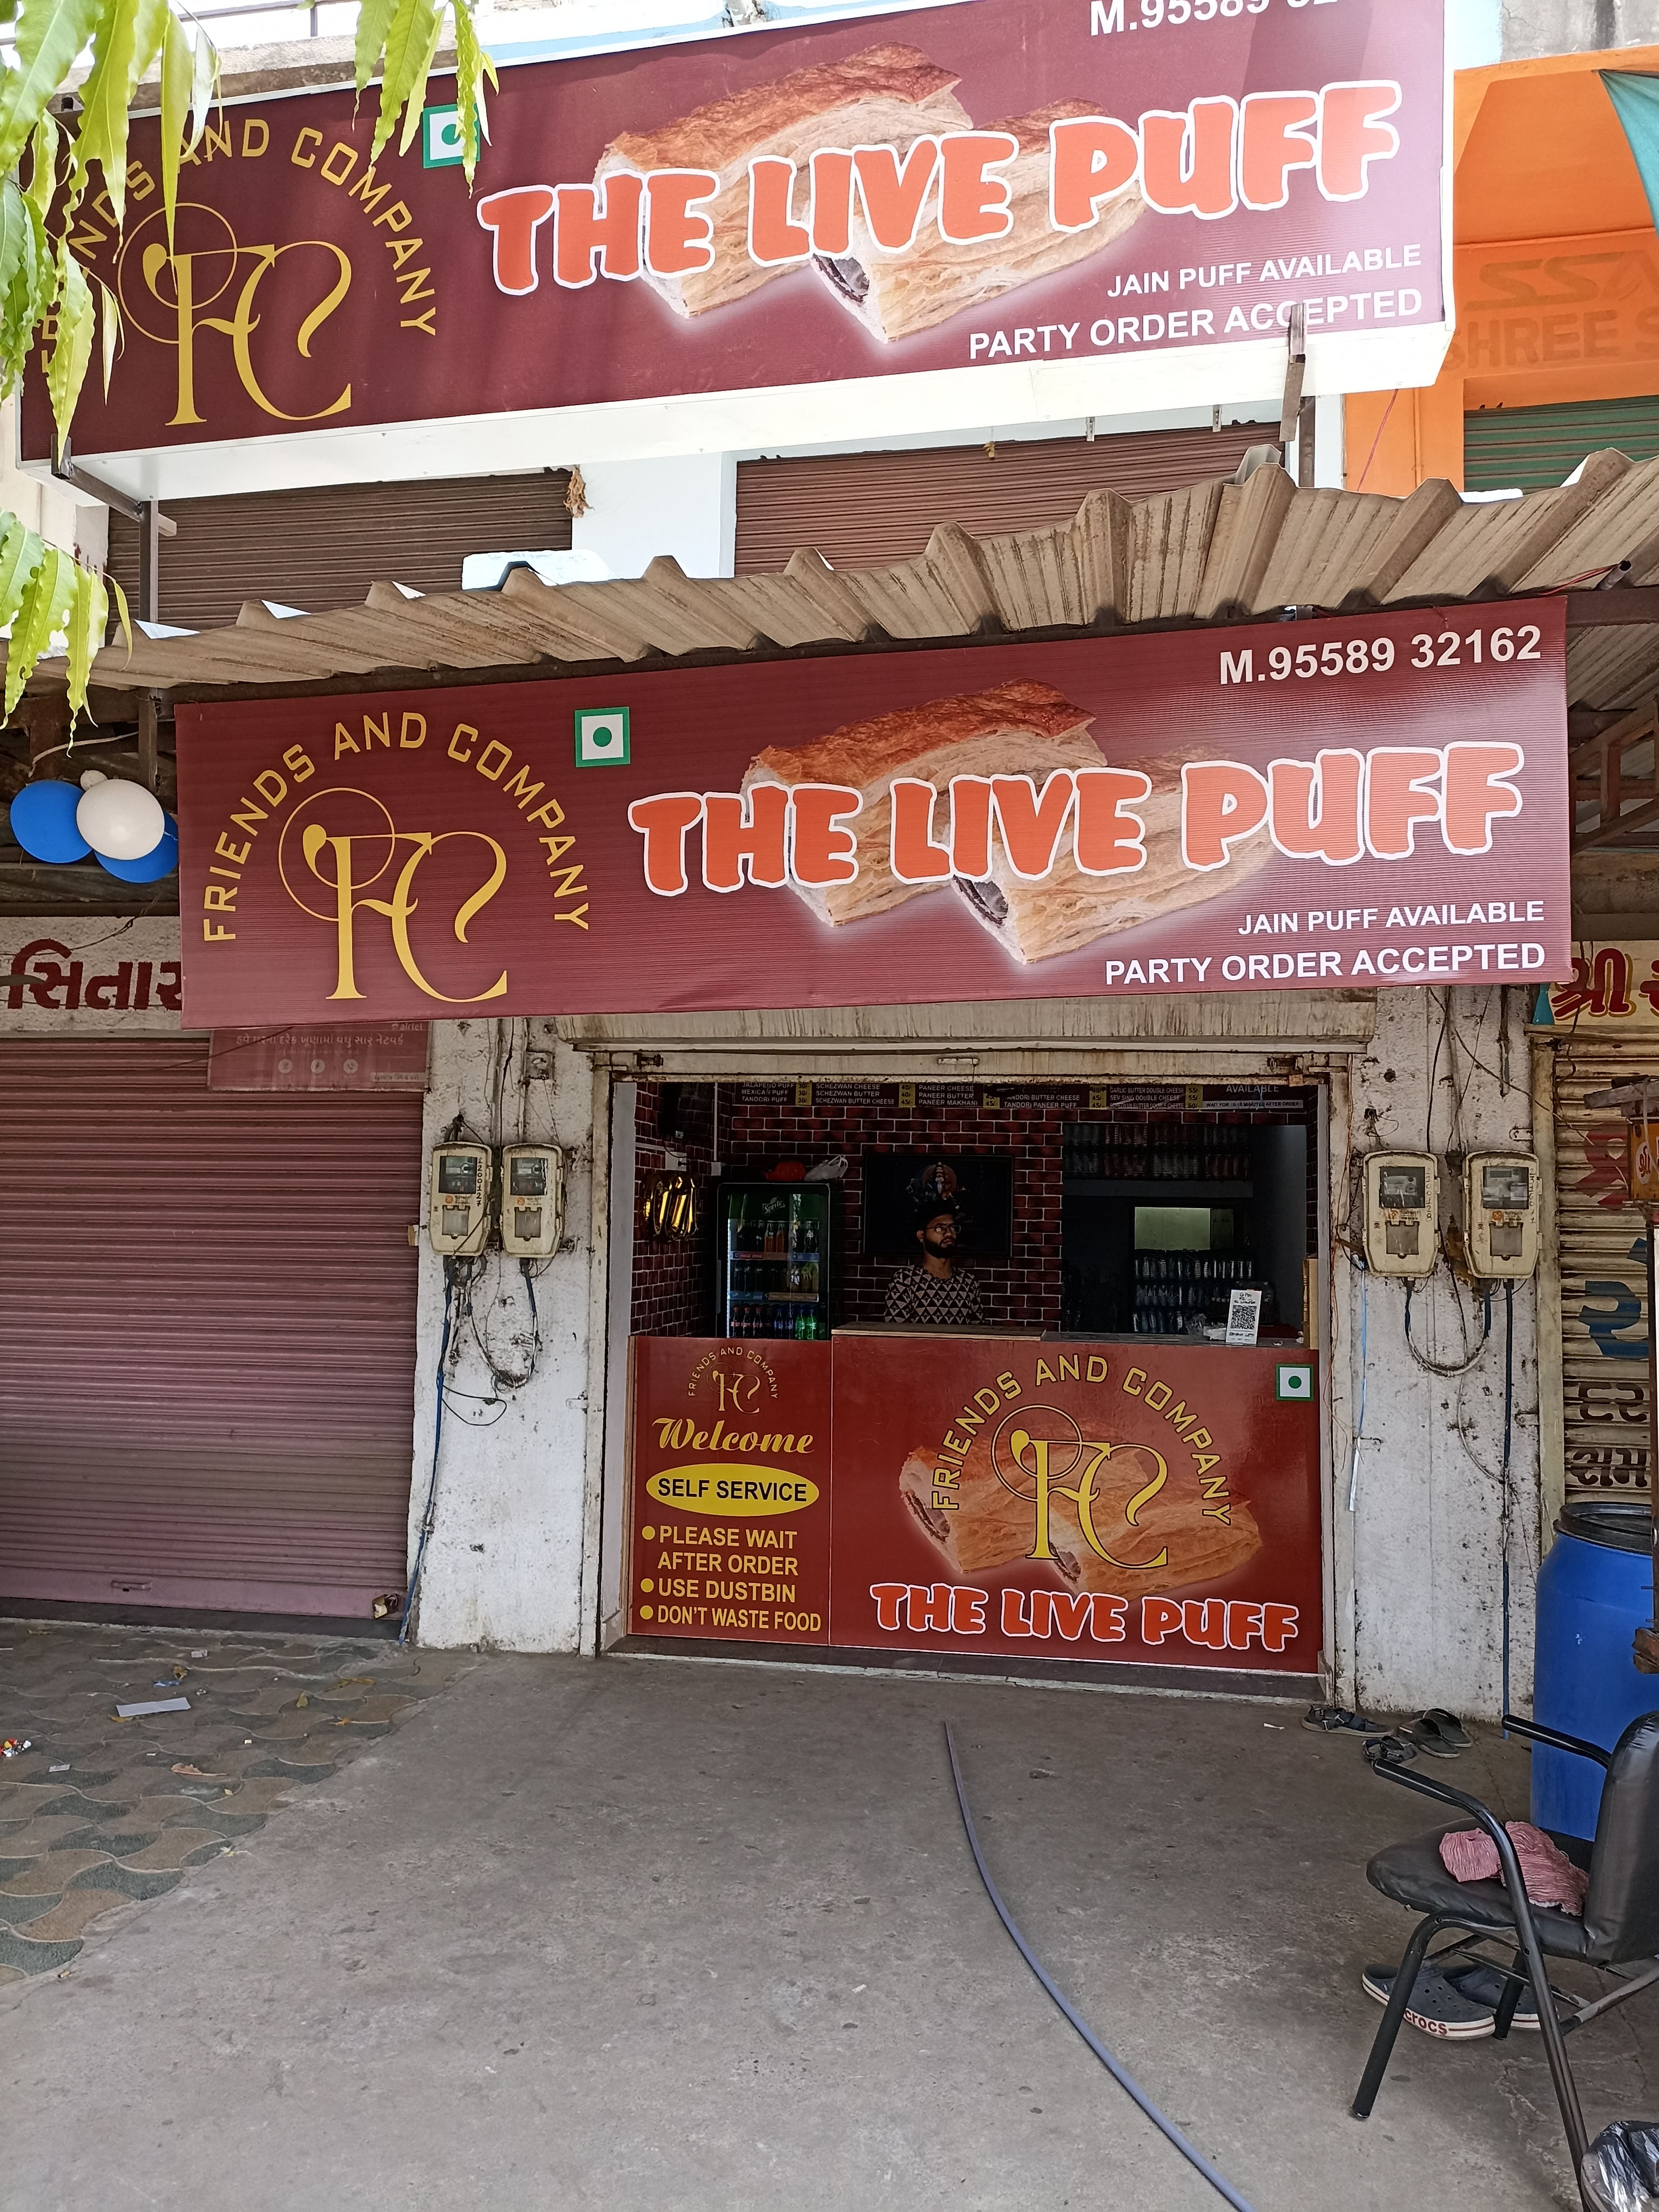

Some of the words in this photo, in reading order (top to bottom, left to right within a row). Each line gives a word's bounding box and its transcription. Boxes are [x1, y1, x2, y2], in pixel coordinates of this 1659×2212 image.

[477, 169, 720, 296] THE
[747, 130, 1020, 267] LIVE
[1049, 80, 1402, 233] PUFF
[291, 127, 436, 336] COMPANY
[1107, 271, 1170, 297] JAIN
[1179, 263, 1252, 289] PUFF
[1259, 244, 1422, 282] AVAILABLE
[969, 323, 1081, 360] PARTY
[1089, 309, 1214, 346] ORDER
[1220, 637, 1395, 685] M.95589
[1410, 625, 1542, 669] 32162
[204, 744, 315, 941] FRIENDS
[334, 712, 427, 760] AND
[447, 723, 589, 931] COMPANY
[628, 781, 863, 896] THE
[890, 767, 1152, 883] LIVE
[1182, 741, 1524, 872] PUFF
[1238, 913, 1298, 935] JAIN
[1308, 908, 1378, 932] PUFF
[1385, 901, 1545, 928] AVAILABLE
[1105, 957, 1212, 985] PARTY
[1221, 951, 1343, 982] ORDER
[1351, 942, 1546, 976] ACCEPTED
[400, 1022, 423, 1030] airtel
[688, 1352, 716, 1396] FRIENDS
[720, 1346, 743, 1356] AND
[747, 1350, 778, 1399] COMPANY
[651, 1417, 815, 1454] Welcome
[932, 1370, 1022, 1510] FRIENDS
[1035, 1354, 1108, 1386] AND
[1122, 1366, 1232, 1527] COMPANY
[658, 1478, 710, 1498] SELF
[716, 1480, 807, 1502] SERVICE
[659, 1525, 739, 1547] PLEASE
[746, 1529, 798, 1549] WAIT
[657, 1552, 722, 1573] AFTER
[727, 1554, 799, 1576] ORDER
[658, 1578, 699, 1598] USE
[705, 1580, 795, 1603] DUSTBIN
[658, 1604, 708, 1625] DON'T
[712, 1608, 770, 1629] WASTE
[774, 1611, 821, 1632] FOOD
[869, 1582, 989, 1635] THE
[1002, 1588, 1129, 1643] LIVE
[1141, 1596, 1299, 1653] PUFF
[1405, 2009, 1447, 2035] crocs
